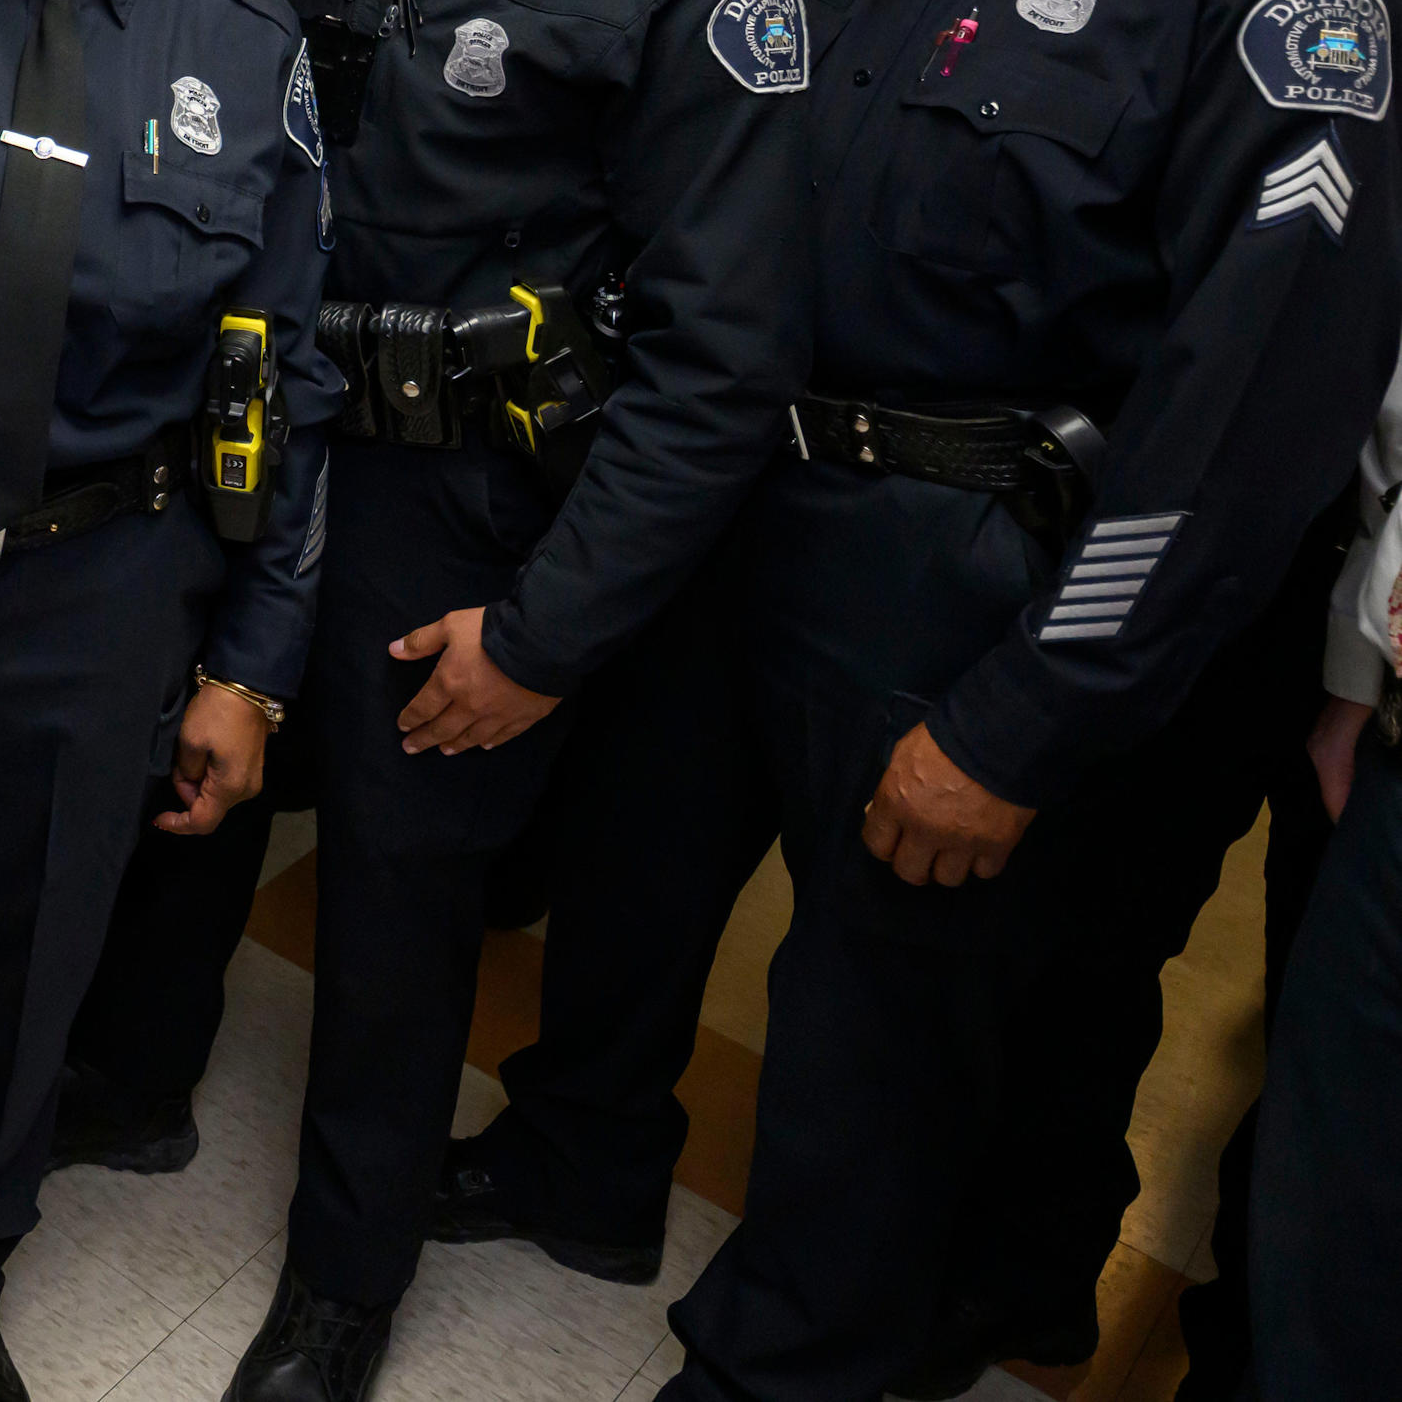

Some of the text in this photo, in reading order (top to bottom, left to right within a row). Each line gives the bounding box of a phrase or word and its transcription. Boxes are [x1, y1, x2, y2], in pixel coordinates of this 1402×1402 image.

[1027, 9, 1065, 27] DETROIT
[1303, 7, 1361, 24] CAPITAL
[744, 14, 776, 69] AUTOMOTIVE
[1285, 20, 1323, 86] AUTOMOTIVE
[754, 68, 802, 85] POLICE
[1283, 85, 1375, 110] POLICE
